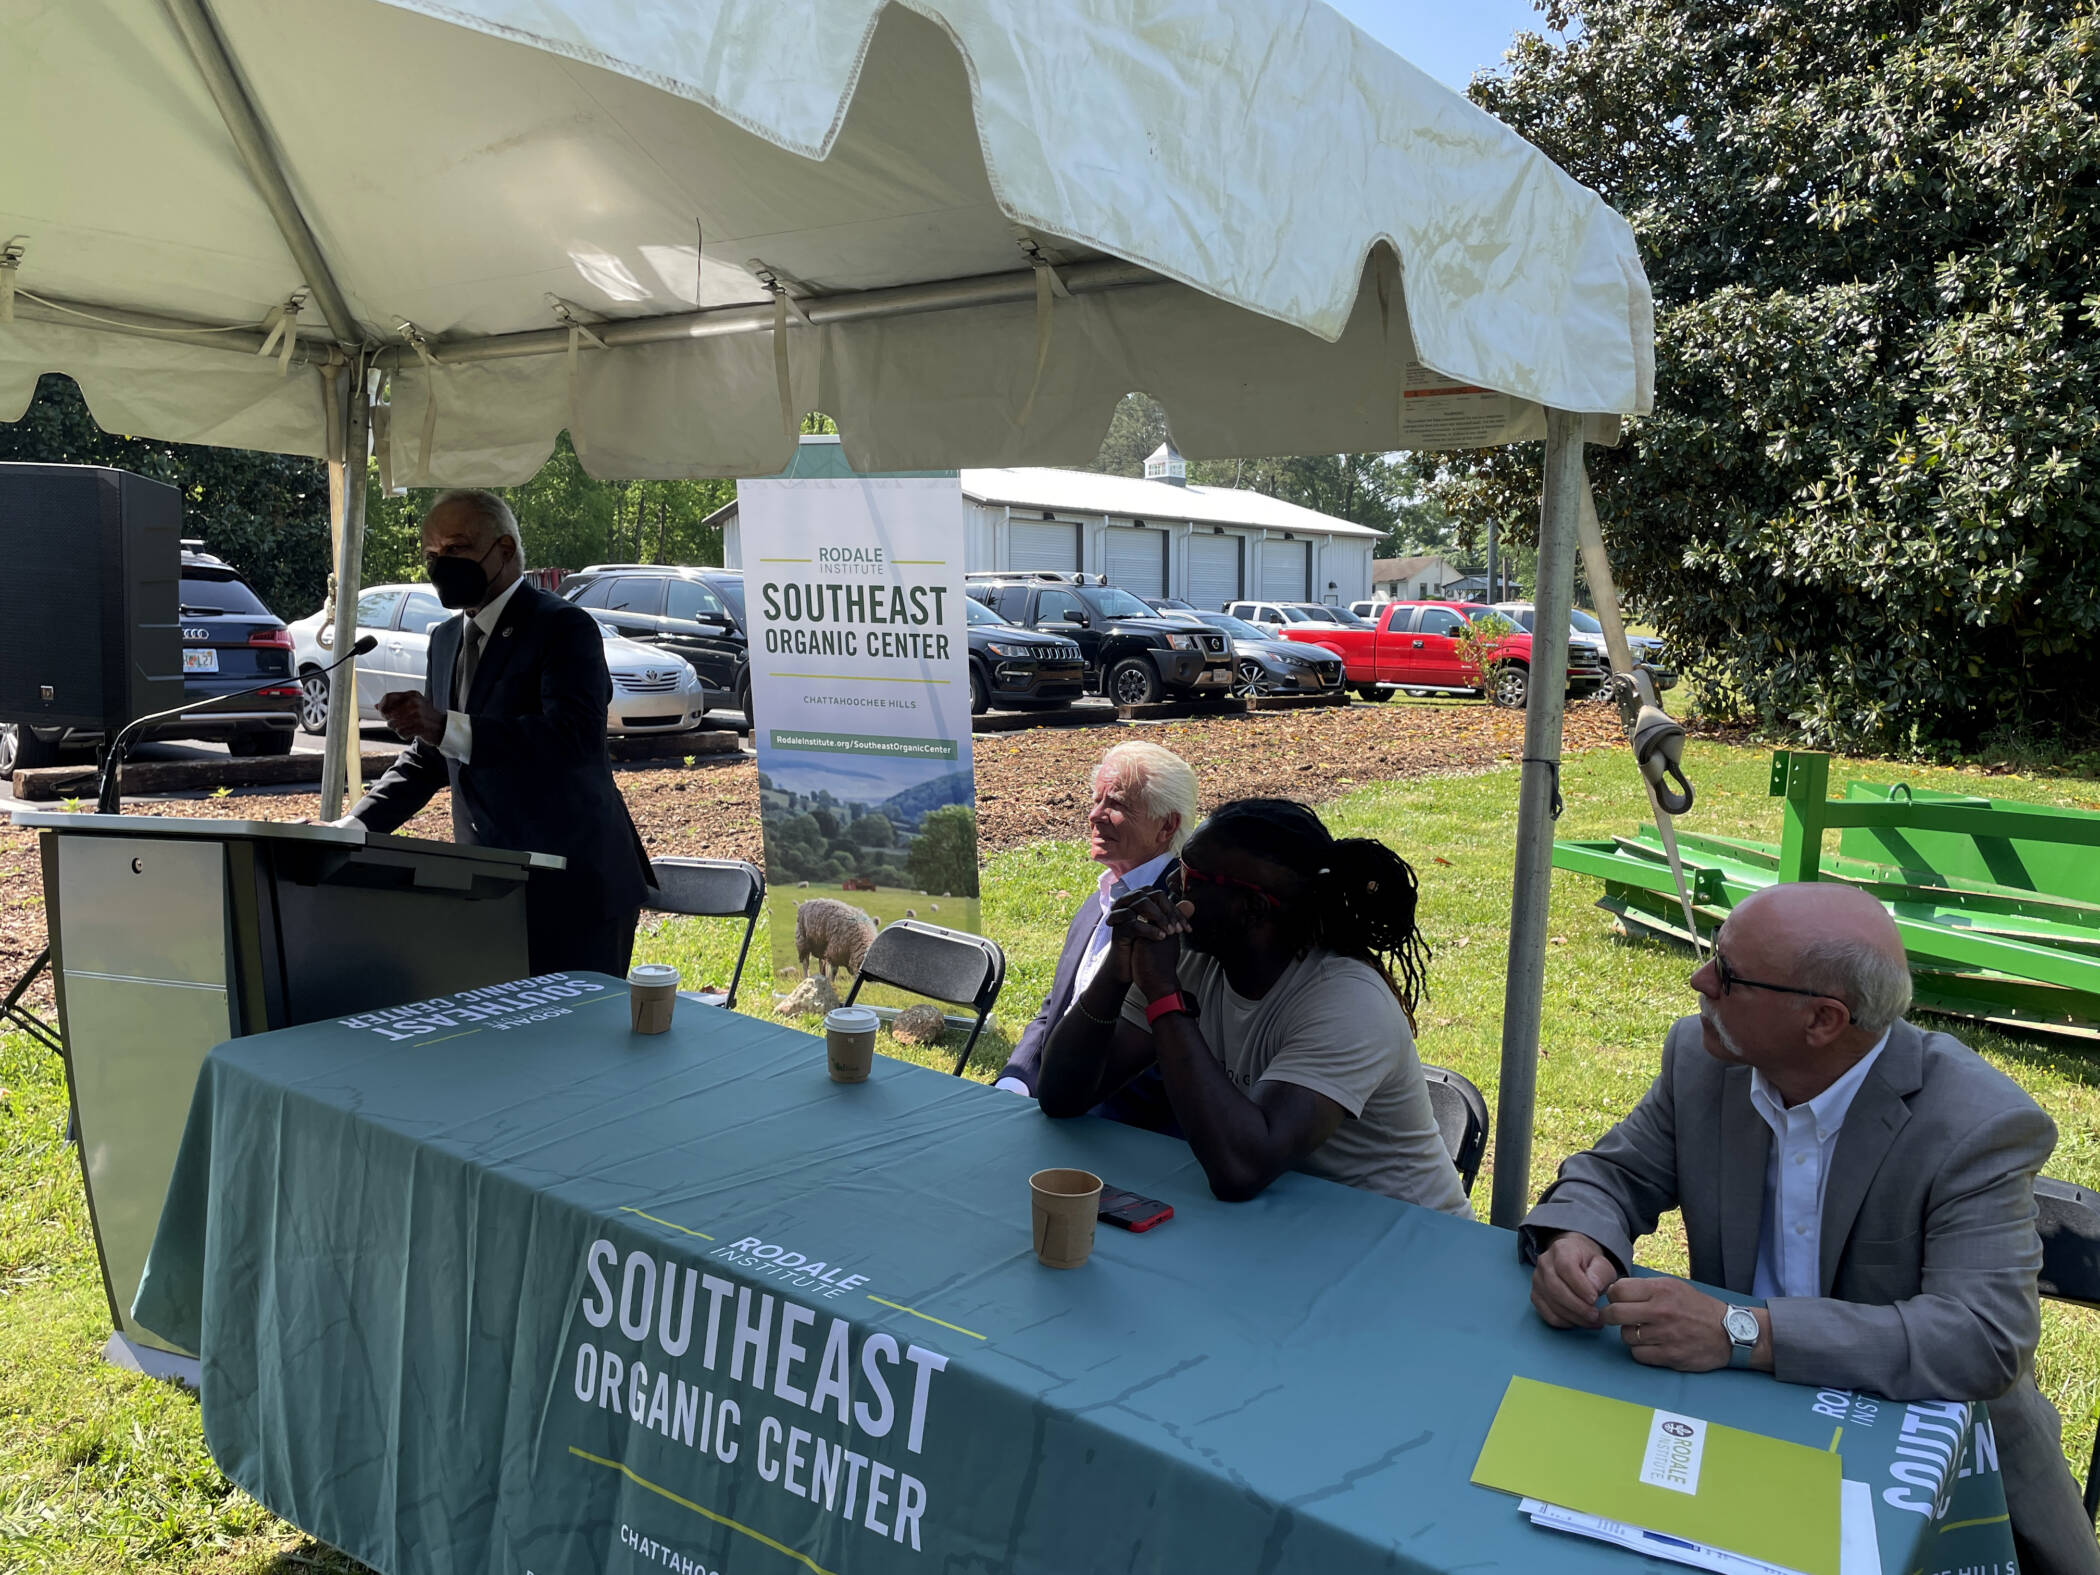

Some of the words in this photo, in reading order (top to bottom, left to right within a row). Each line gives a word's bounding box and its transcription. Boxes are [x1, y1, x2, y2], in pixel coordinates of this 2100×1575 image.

[819, 547, 883, 562] RODALE
[820, 563, 884, 575] INSTITUTE
[762, 582, 947, 626] SOUTHEAST
[765, 628, 857, 657] ORGANIC
[866, 631, 950, 660] CENTER
[803, 695, 886, 708] CHATTAHOOCHEE
[888, 700, 917, 709] HILLS
[776, 735, 952, 754] RodaleInstitute.org/SoutheastOrganicCenter
[454, 972, 569, 1002] ORGANIC
[338, 997, 455, 1029] CENTER
[371, 979, 605, 1041] SOUTHEAST
[492, 1007, 574, 1031] RODALE
[709, 1246, 846, 1300] INSTITUTE
[728, 1236, 871, 1290] RODALE
[582, 1239, 951, 1454] SOUTHEAST
[574, 1343, 741, 1464] ORGANIC
[757, 1416, 928, 1552] CENTER
[1667, 1437, 1693, 1485] RODALE
